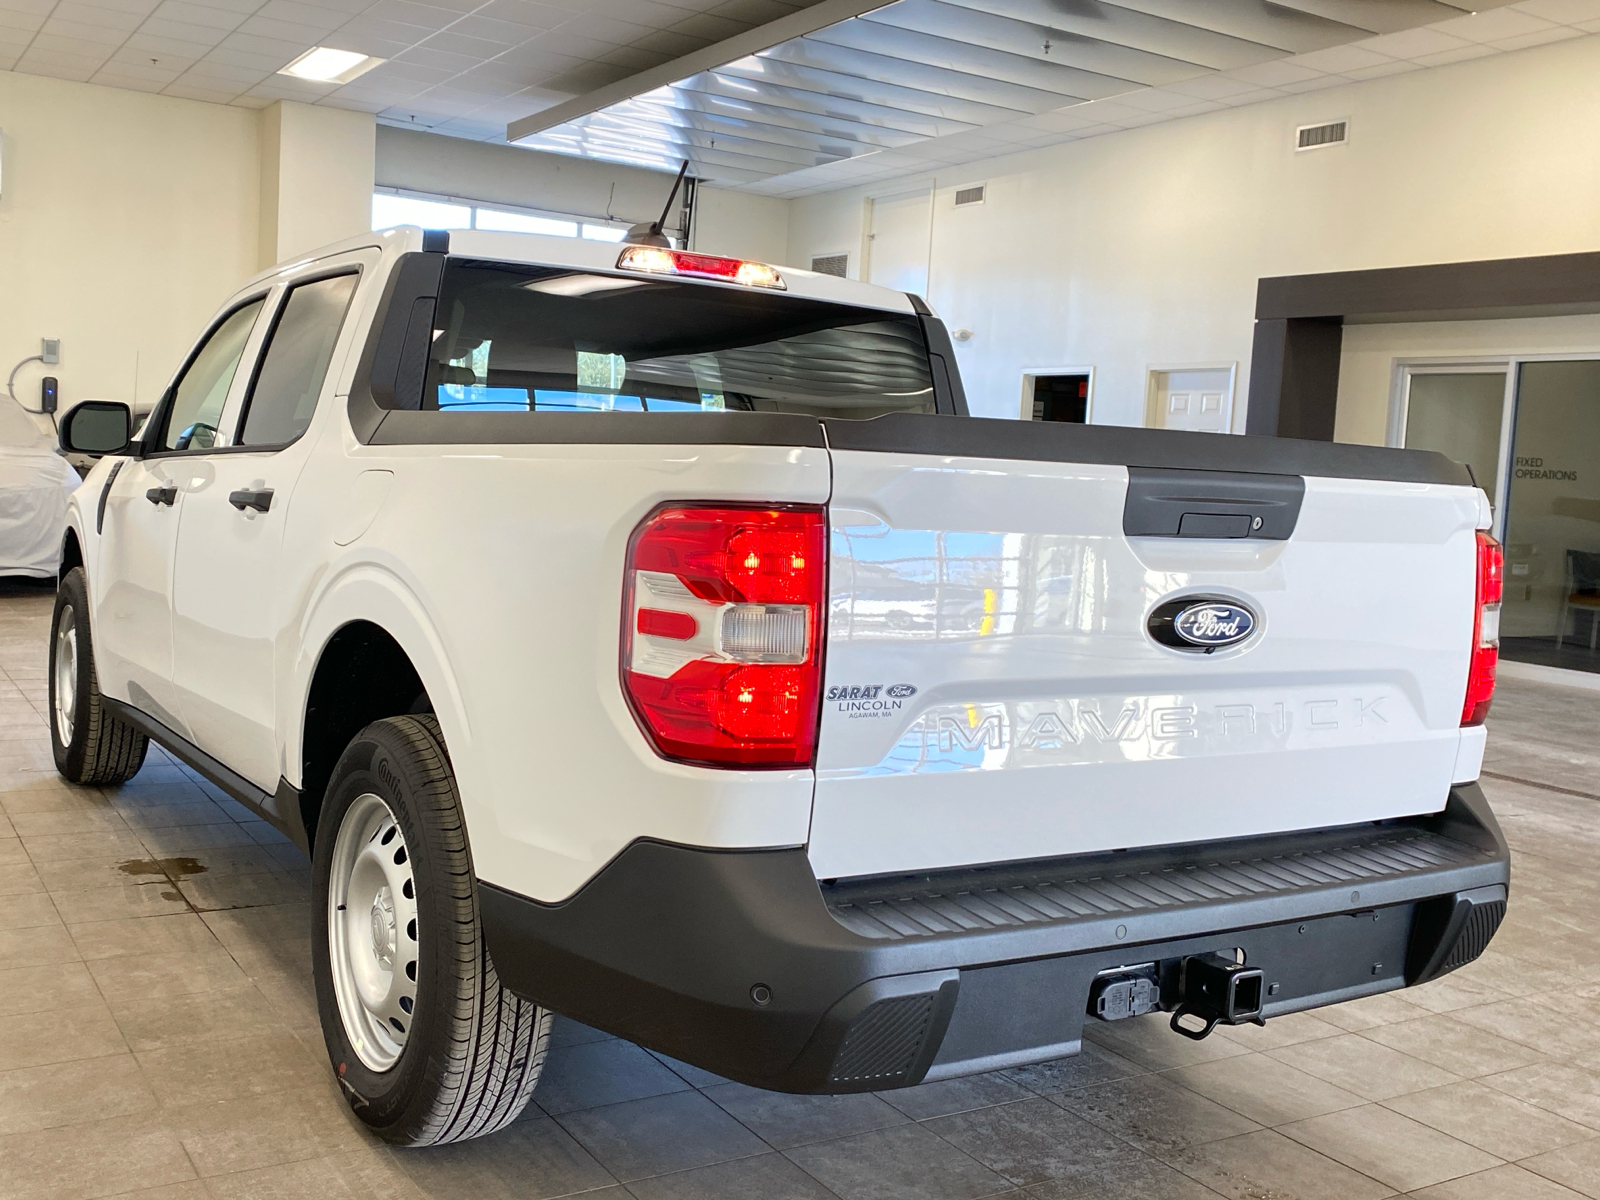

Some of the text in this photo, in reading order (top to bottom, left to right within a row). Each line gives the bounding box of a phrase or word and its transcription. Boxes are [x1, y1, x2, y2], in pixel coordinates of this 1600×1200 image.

[1516, 457, 1543, 468] FIXED
[1515, 469, 1577, 481] OPERATIONS
[1190, 607, 1241, 637] Ford
[826, 684, 913, 700] SARAT Ford
[838, 700, 902, 711] LINCOLN
[937, 697, 1389, 752] MAVERICK
[378, 757, 420, 852] Continental
